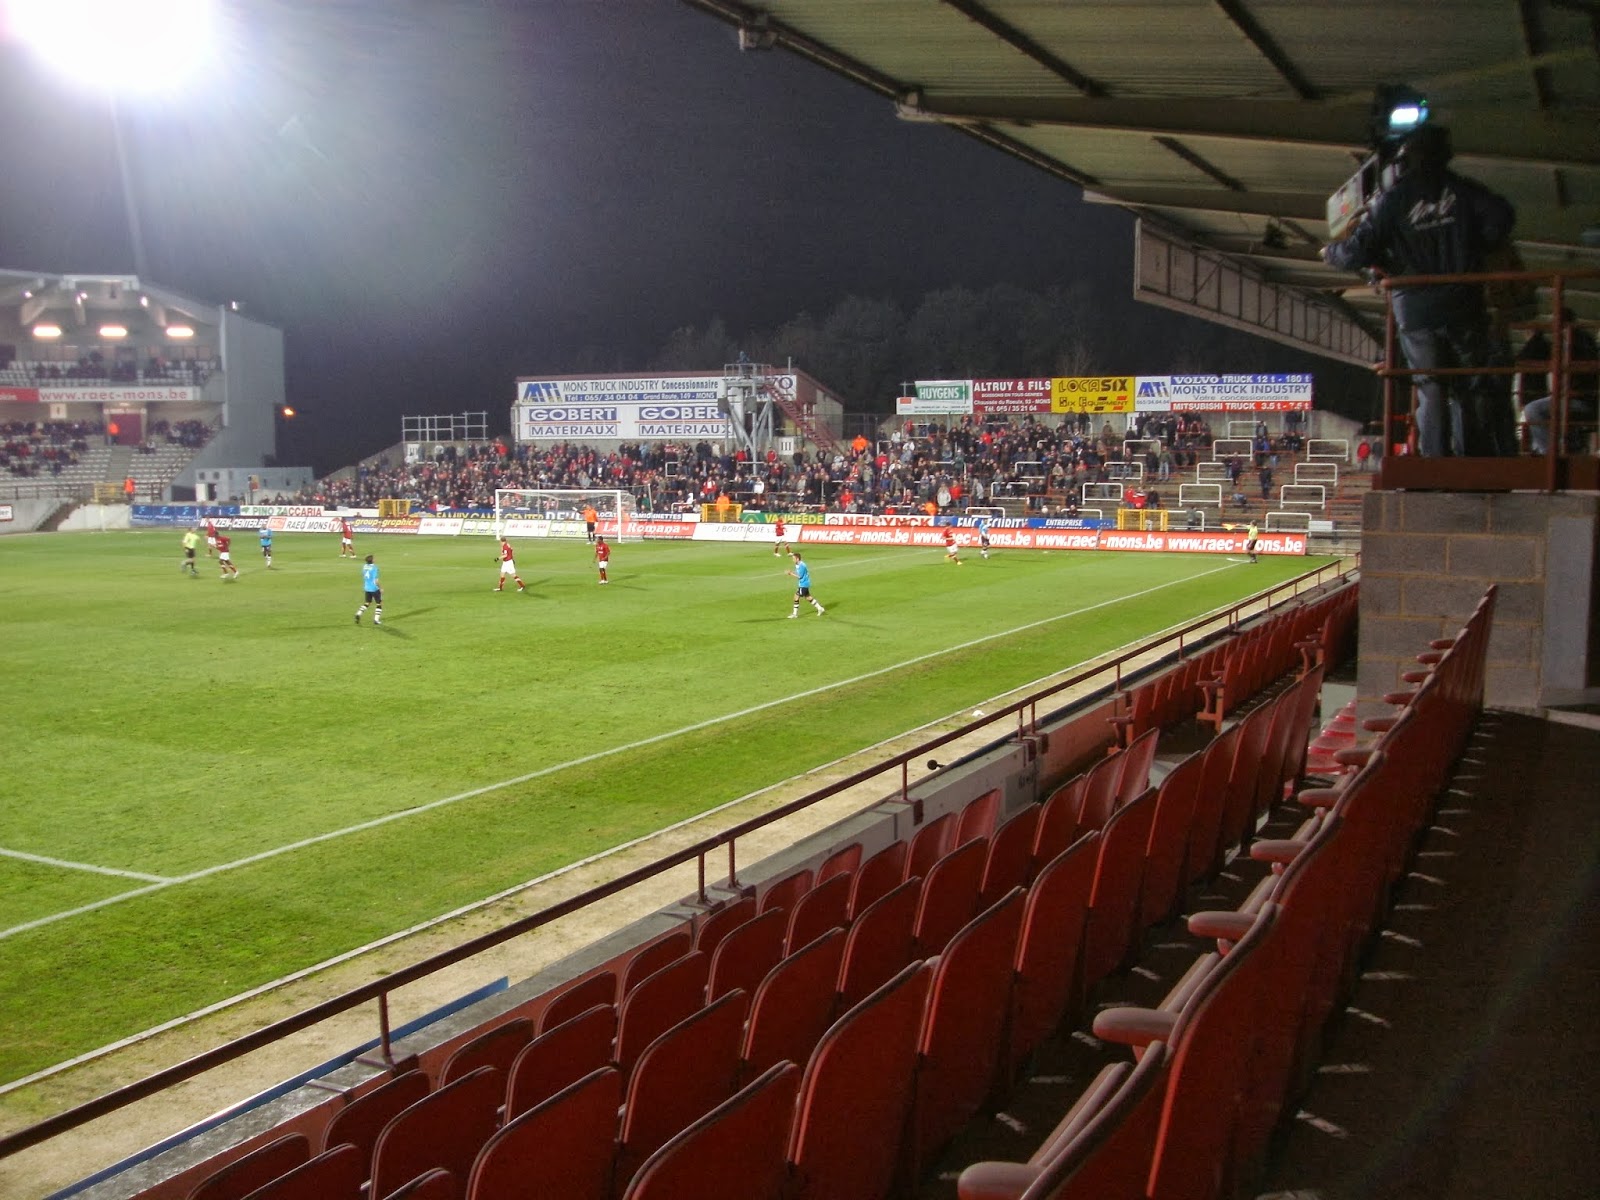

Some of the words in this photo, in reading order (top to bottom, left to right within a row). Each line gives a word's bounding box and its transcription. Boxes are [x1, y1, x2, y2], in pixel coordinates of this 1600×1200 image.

[1172, 376, 1219, 384] VOLVO
[1222, 375, 1253, 383] TRUCK
[1257, 375, 1268, 383] 12
[1270, 375, 1276, 383] t
[1285, 375, 1301, 383] 180
[1304, 375, 1310, 383] t
[563, 382, 588, 392] MONS
[590, 381, 616, 391] TRUCK
[618, 380, 660, 391] INDUSTRY
[661, 379, 719, 390] Concessionnaire
[973, 381, 1014, 392] ALTRUY
[1017, 381, 1024, 391] &
[1028, 380, 1052, 391] FILS
[1058, 379, 1129, 393] LOCASIX
[1172, 385, 1208, 395] MONS
[1210, 385, 1248, 394] TRUCK
[1251, 384, 1309, 394] INDUSTRY
[40, 389, 188, 400] www.raec-mons.be
[604, 393, 614, 401] 34
[615, 393, 626, 401] 04
[919, 387, 960, 400] HUYGENS
[1172, 402, 1223, 410] MITSUBISHI
[1225, 402, 1256, 410] TRUCK
[1261, 402, 1276, 410] 3.5
[1276, 402, 1282, 410] t
[531, 408, 615, 421] GOBERT
[641, 407, 728, 420] GOBER
[531, 425, 615, 436] MATERIAUX
[641, 424, 731, 435] MATERIAUX
[252, 506, 275, 516] PINO
[276, 506, 323, 517] ZACCARIA
[308, 521, 328, 531] MONS
[626, 522, 681, 534] Romana
[1046, 519, 1083, 527] ENTREPRISE
[802, 529, 909, 543] www.raec-mons.be
[1035, 533, 1163, 549] www.raec-mons.be
